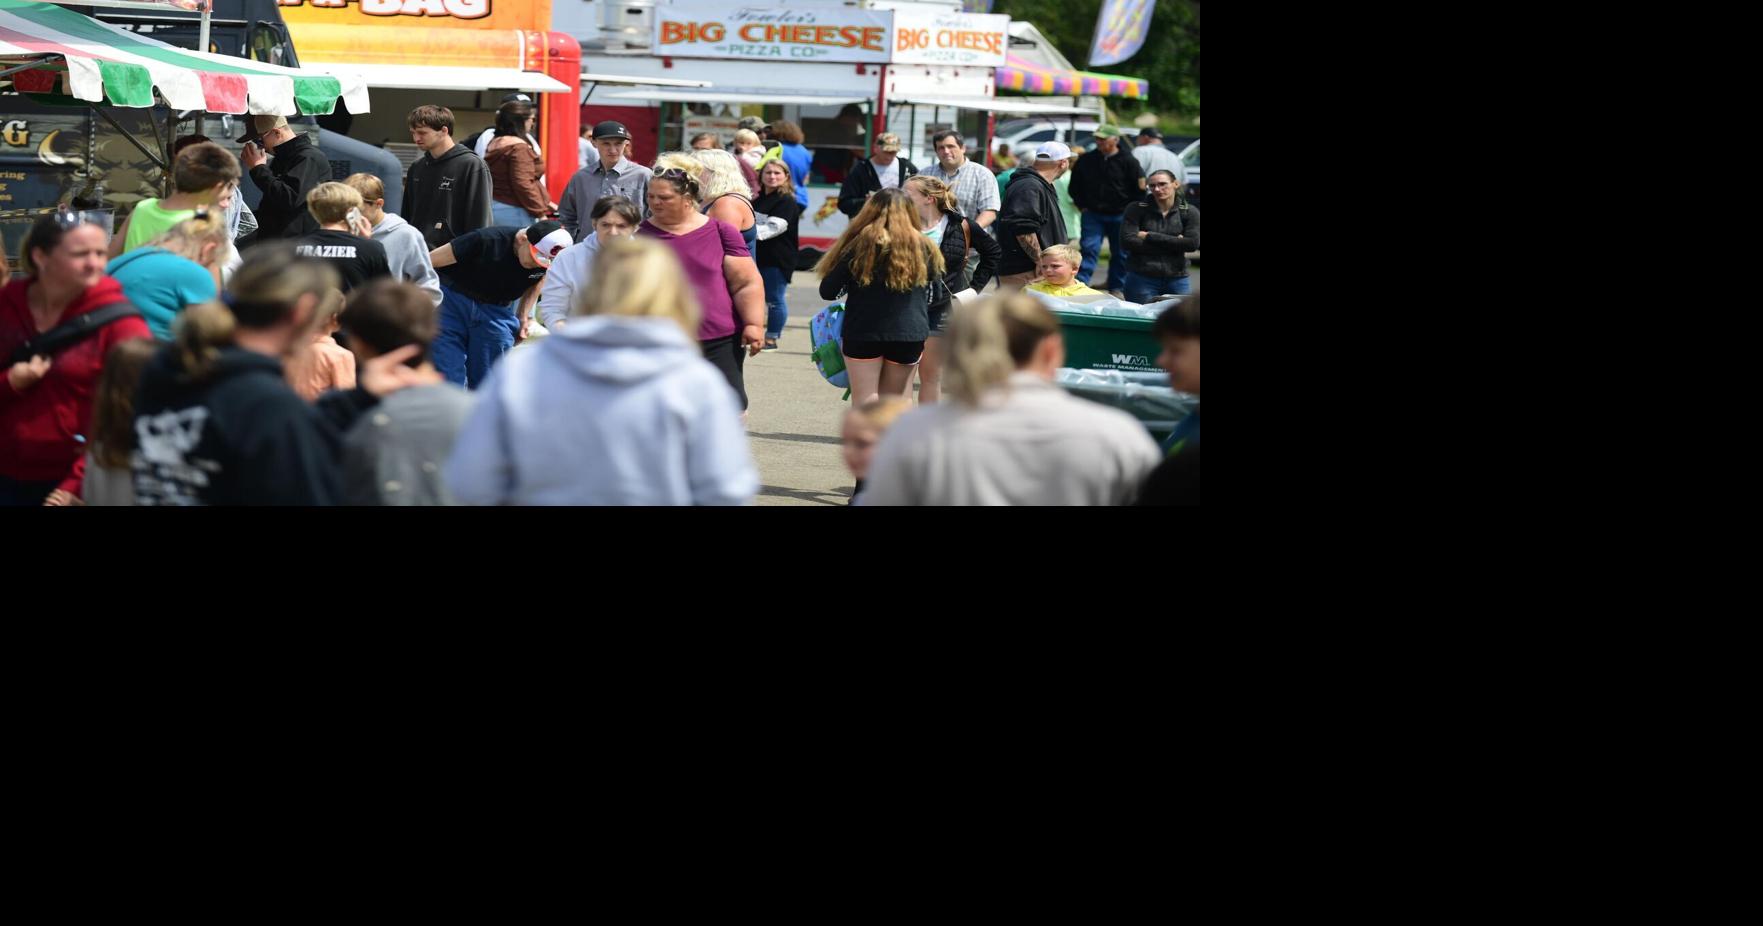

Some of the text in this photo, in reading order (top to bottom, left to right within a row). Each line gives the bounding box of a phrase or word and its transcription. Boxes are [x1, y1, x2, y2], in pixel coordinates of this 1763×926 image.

[660, 22, 885, 52] BIG CHEESE
[897, 28, 1003, 55] BIG CHEESE
[729, 44, 816, 57] PIZZA CO
[296, 245, 357, 258] FRAZIER
[1112, 354, 1149, 366] WM
